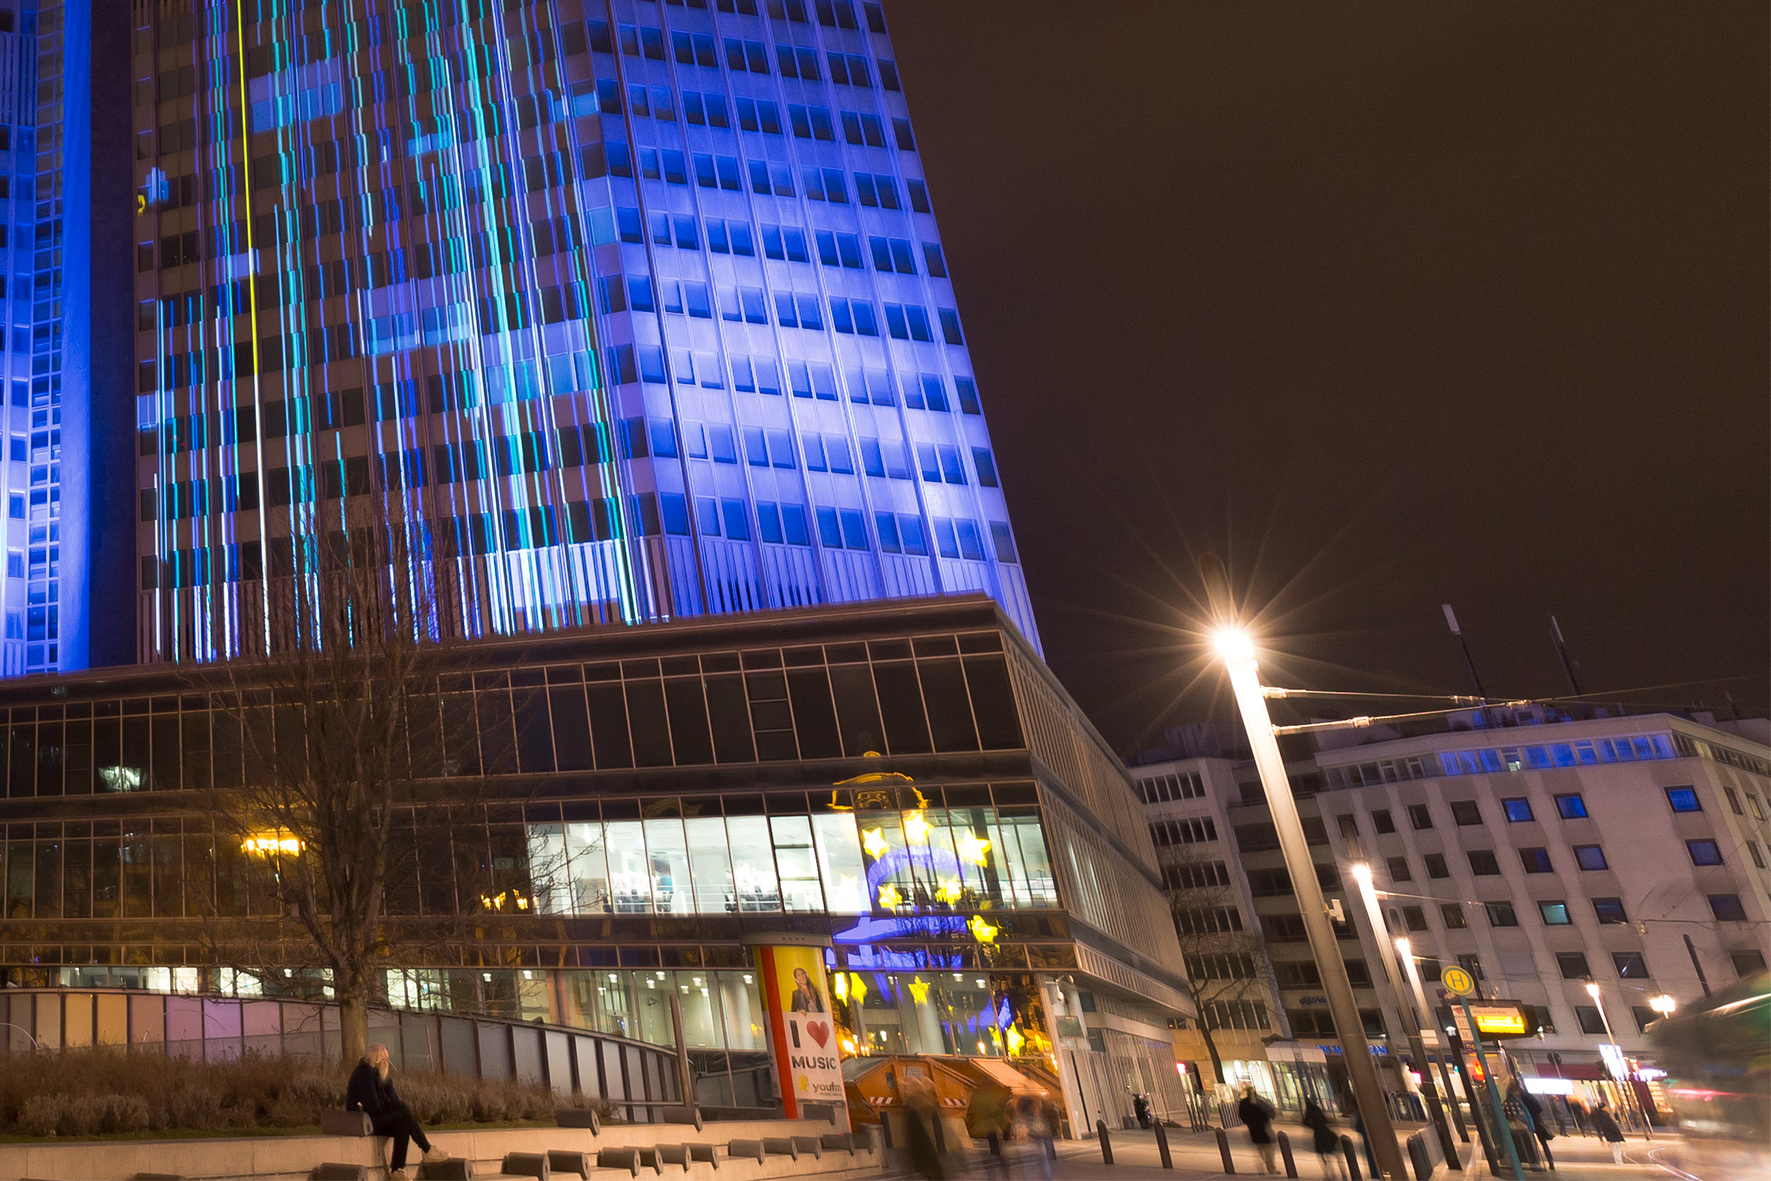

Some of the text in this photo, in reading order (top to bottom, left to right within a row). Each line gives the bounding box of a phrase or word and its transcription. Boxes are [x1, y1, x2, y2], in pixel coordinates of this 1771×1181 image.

[1449, 972, 1465, 988] H
[790, 1020, 801, 1048] I
[791, 1056, 837, 1070] MUSIC
